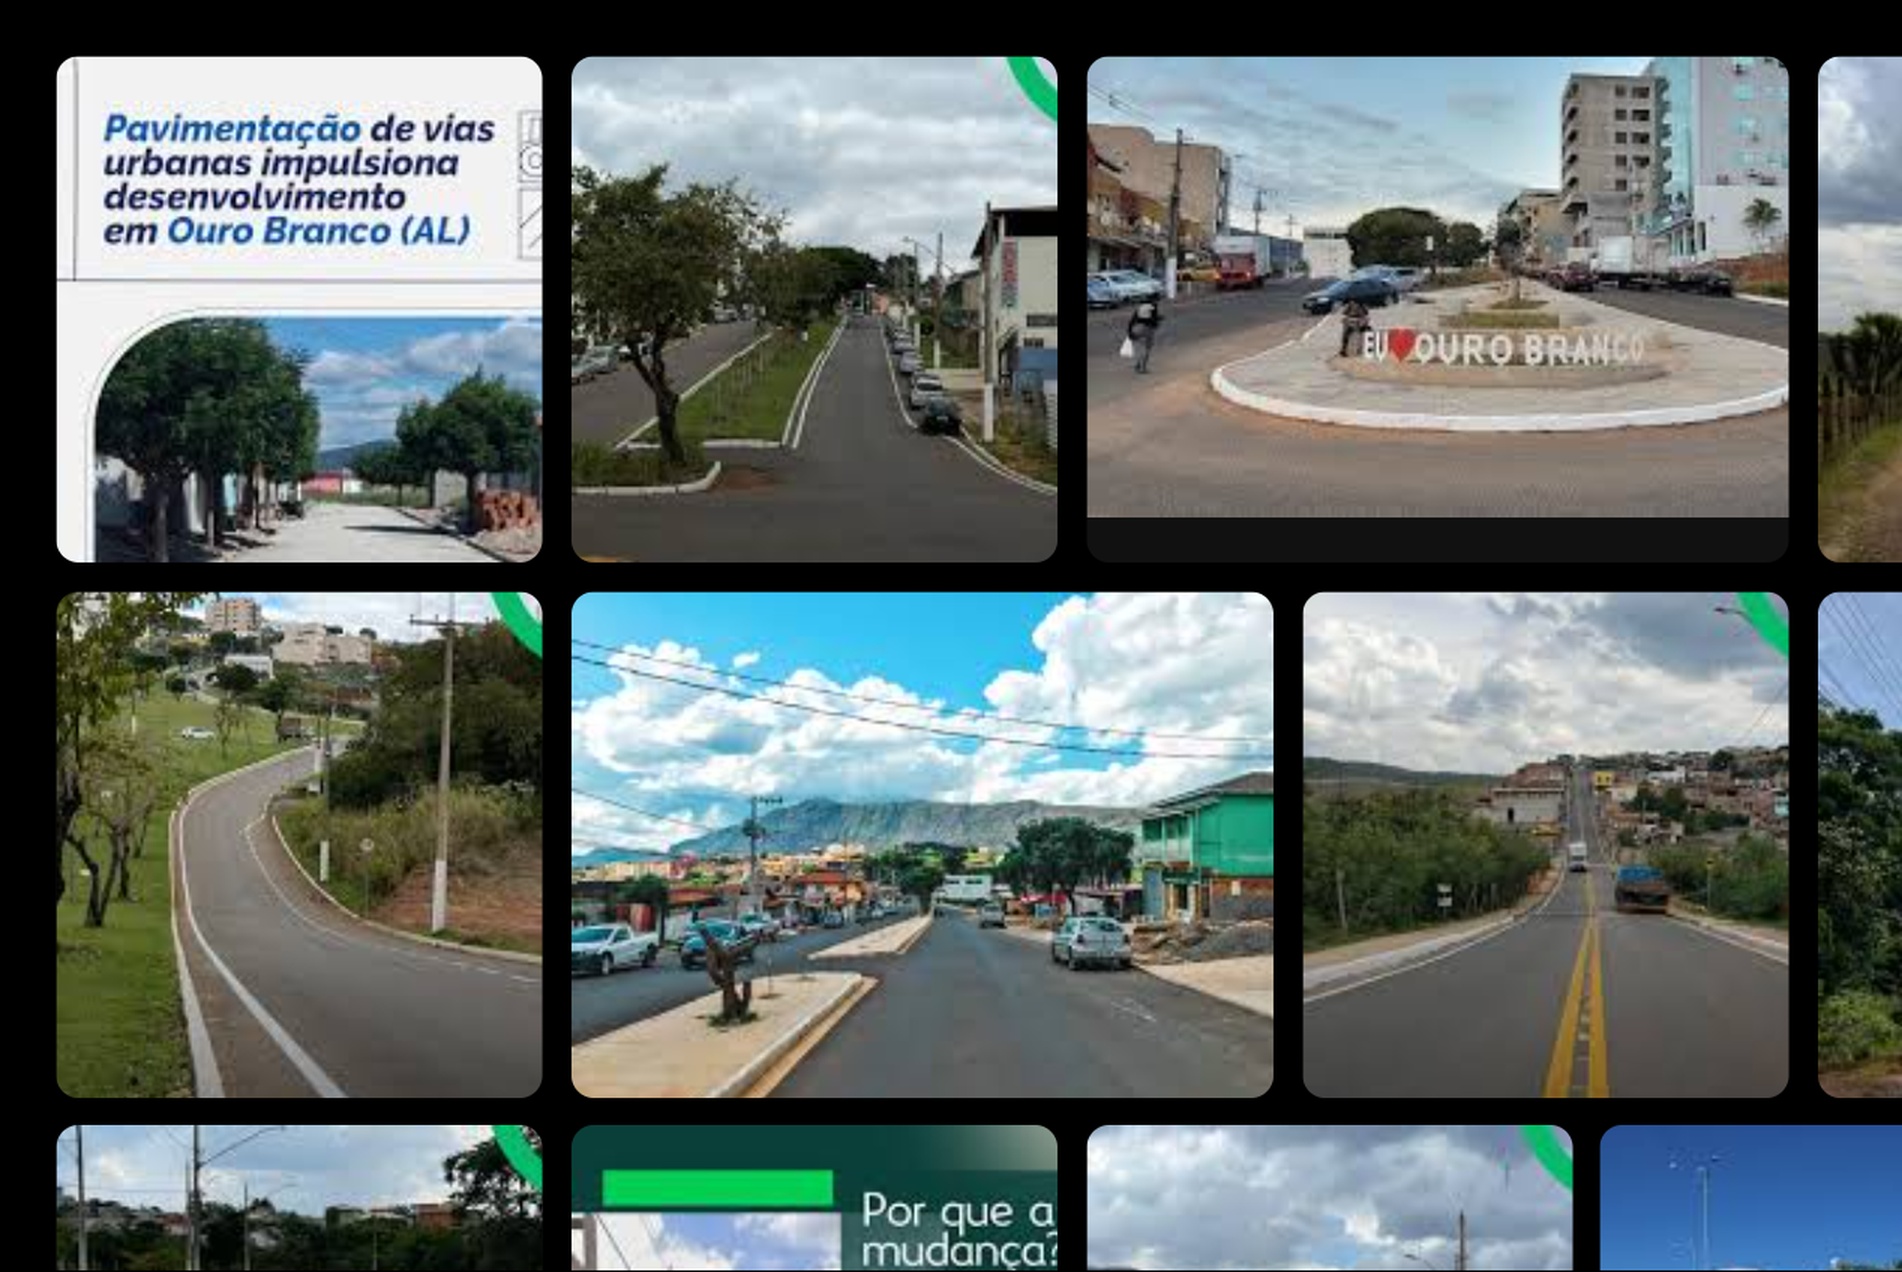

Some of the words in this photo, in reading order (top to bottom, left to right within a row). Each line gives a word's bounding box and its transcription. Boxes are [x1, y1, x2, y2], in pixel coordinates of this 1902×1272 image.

[1363, 331, 1388, 363] EU
[1415, 333, 1513, 366] OURO
[1524, 332, 1646, 367] BRANCO
